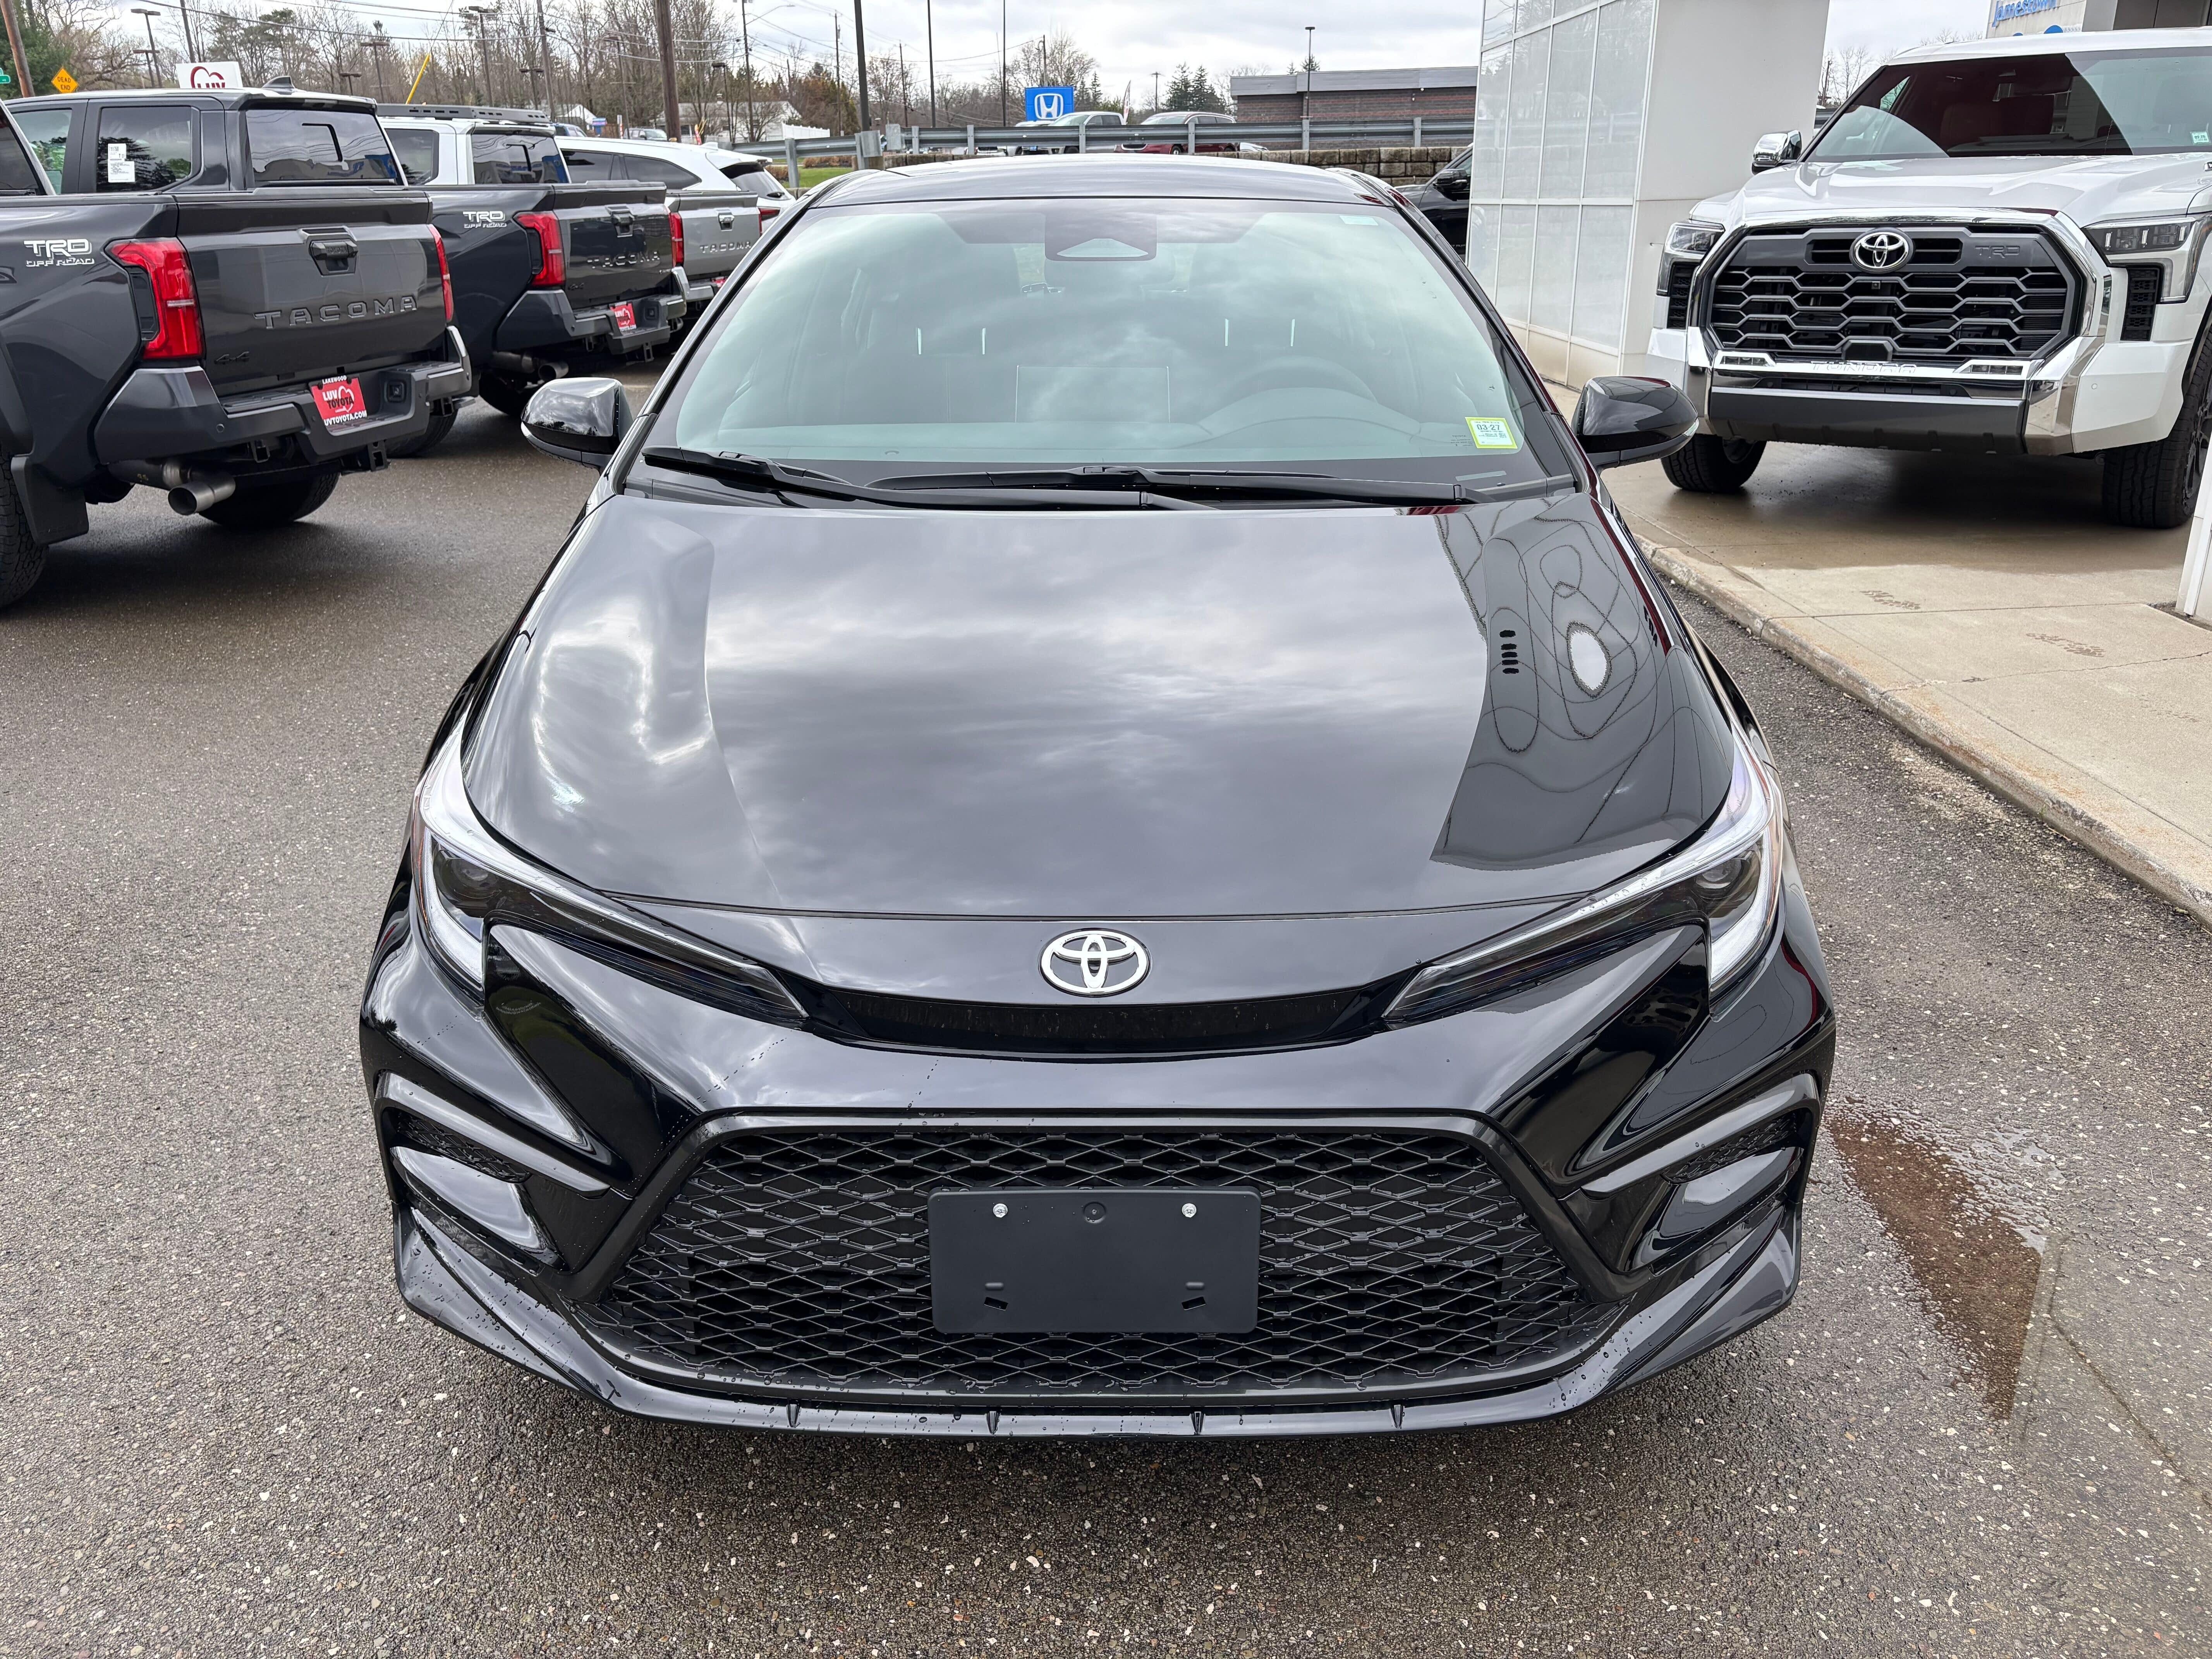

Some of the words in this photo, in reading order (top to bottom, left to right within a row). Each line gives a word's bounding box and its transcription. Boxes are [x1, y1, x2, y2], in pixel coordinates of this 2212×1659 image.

[463, 211, 505, 222] TRD
[24, 239, 92, 258] TRD
[700, 241, 751, 253] TACOMA
[1975, 246, 2020, 258] TRD
[587, 251, 660, 269] TACOMA
[253, 296, 417, 329] TACOMA
[1811, 361, 1917, 373] TUNDRA
[322, 375, 347, 385] LAKEWOOD
[322, 390, 337, 401] LUV
[327, 397, 354, 409] TOYOTA
[324, 410, 368, 426] UVTOYOTA.COM
